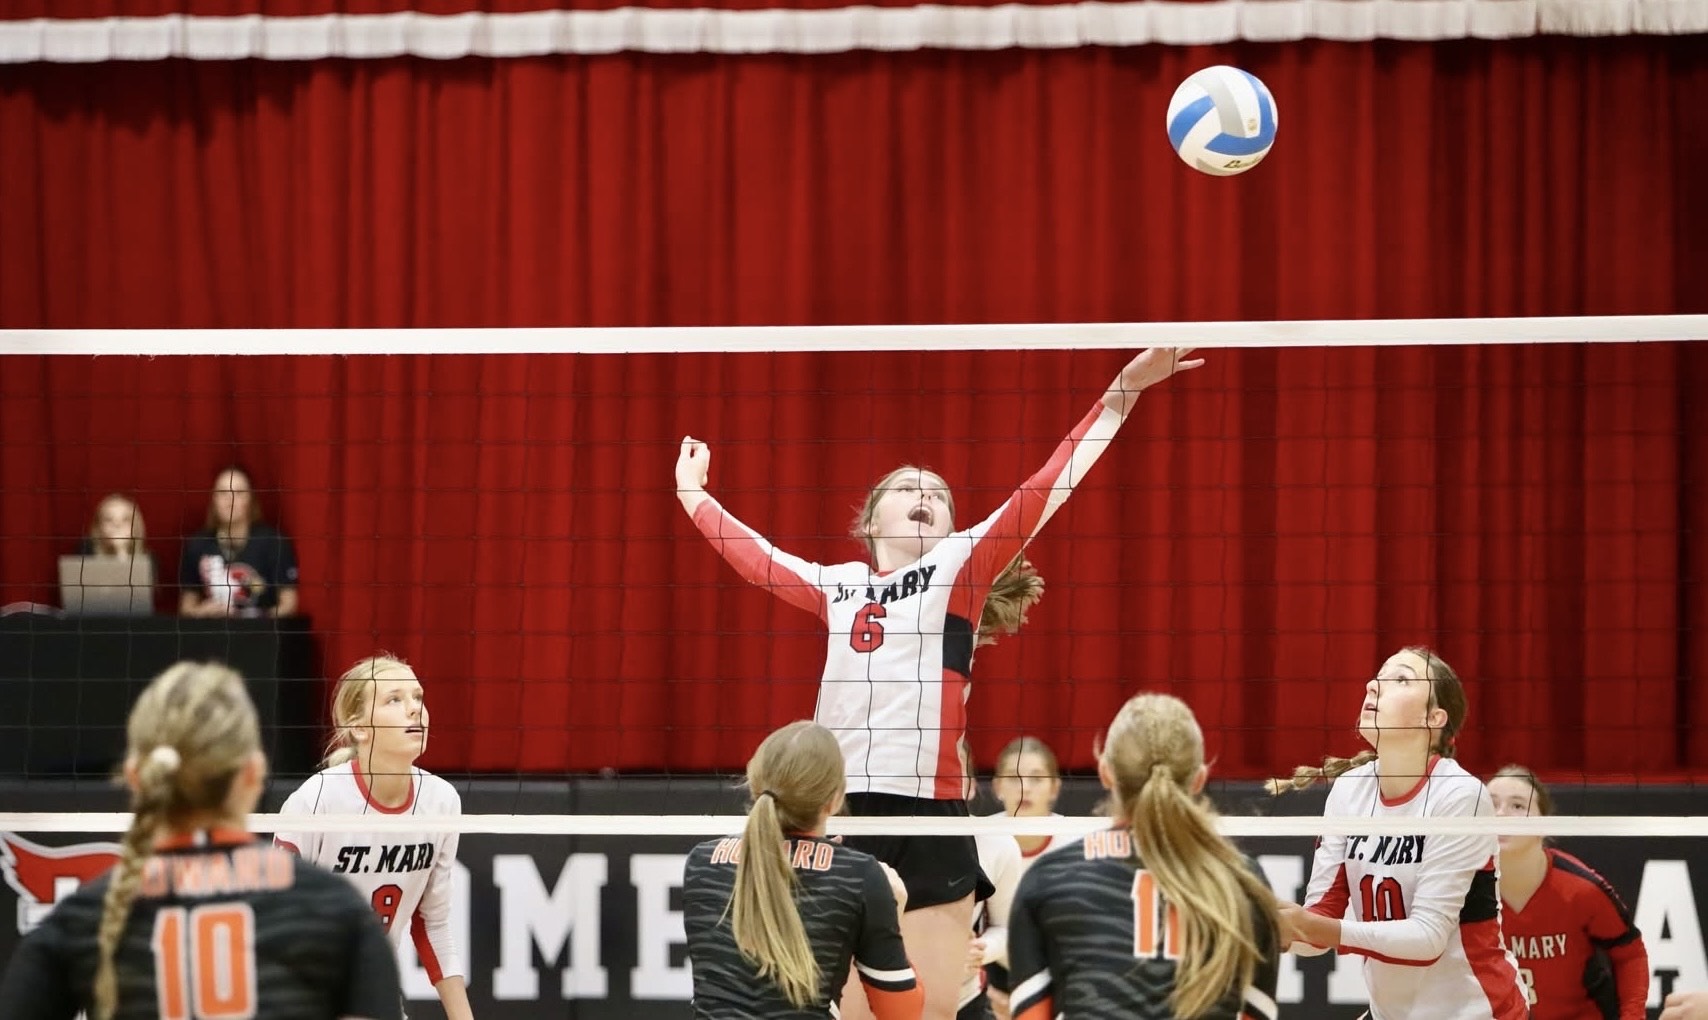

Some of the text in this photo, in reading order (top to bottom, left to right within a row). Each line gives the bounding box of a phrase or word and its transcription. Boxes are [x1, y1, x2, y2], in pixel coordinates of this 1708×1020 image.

[850, 602, 887, 653] 6
[332, 846, 371, 873] ST.
[371, 884, 403, 935] 9
[1360, 874, 1407, 922] 10
[152, 903, 258, 1020] 10
[1510, 934, 1567, 959] MARY
